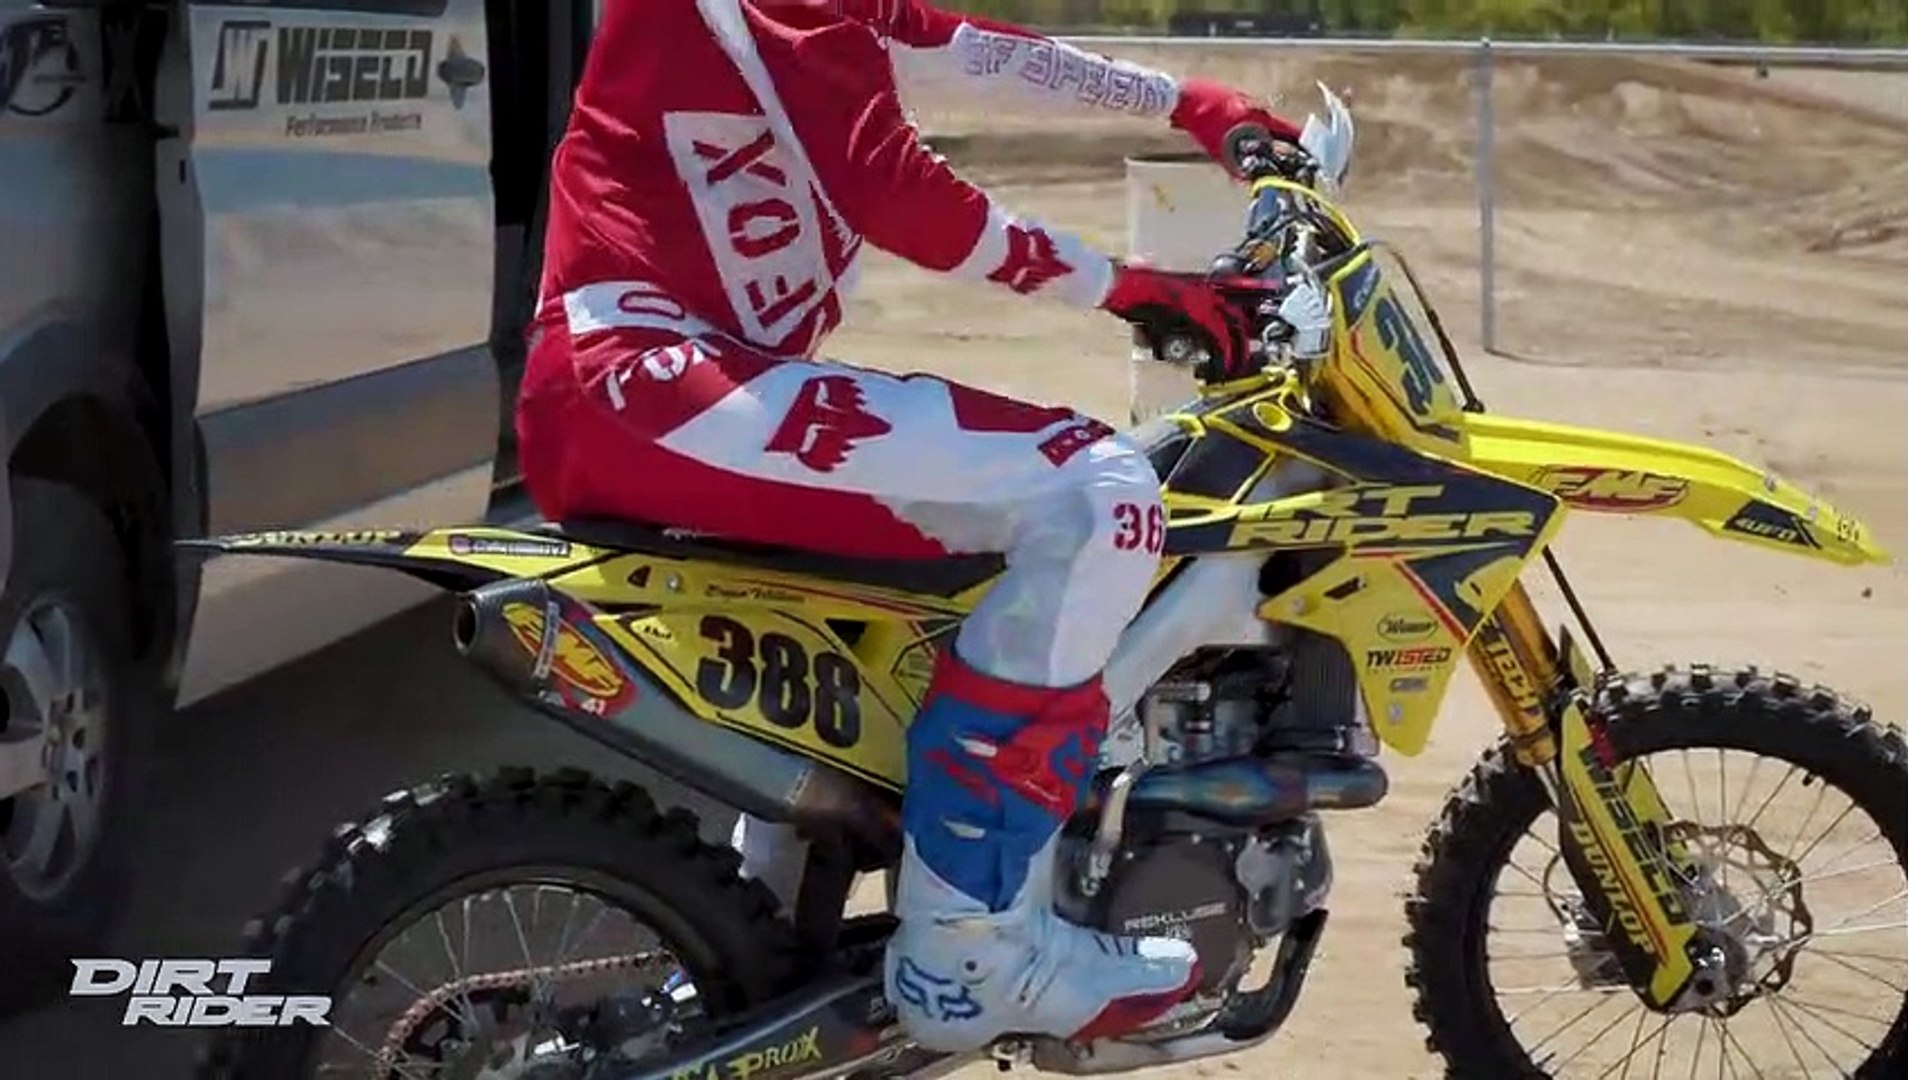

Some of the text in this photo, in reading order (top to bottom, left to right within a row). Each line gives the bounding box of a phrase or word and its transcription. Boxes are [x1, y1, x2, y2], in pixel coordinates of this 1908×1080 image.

[692, 127, 817, 331] FOX
[1226, 511, 1535, 549] RIDER
[698, 615, 861, 748] 388
[1366, 647, 1452, 668] TWISTED
[1568, 819, 1656, 955] DUNLOP
